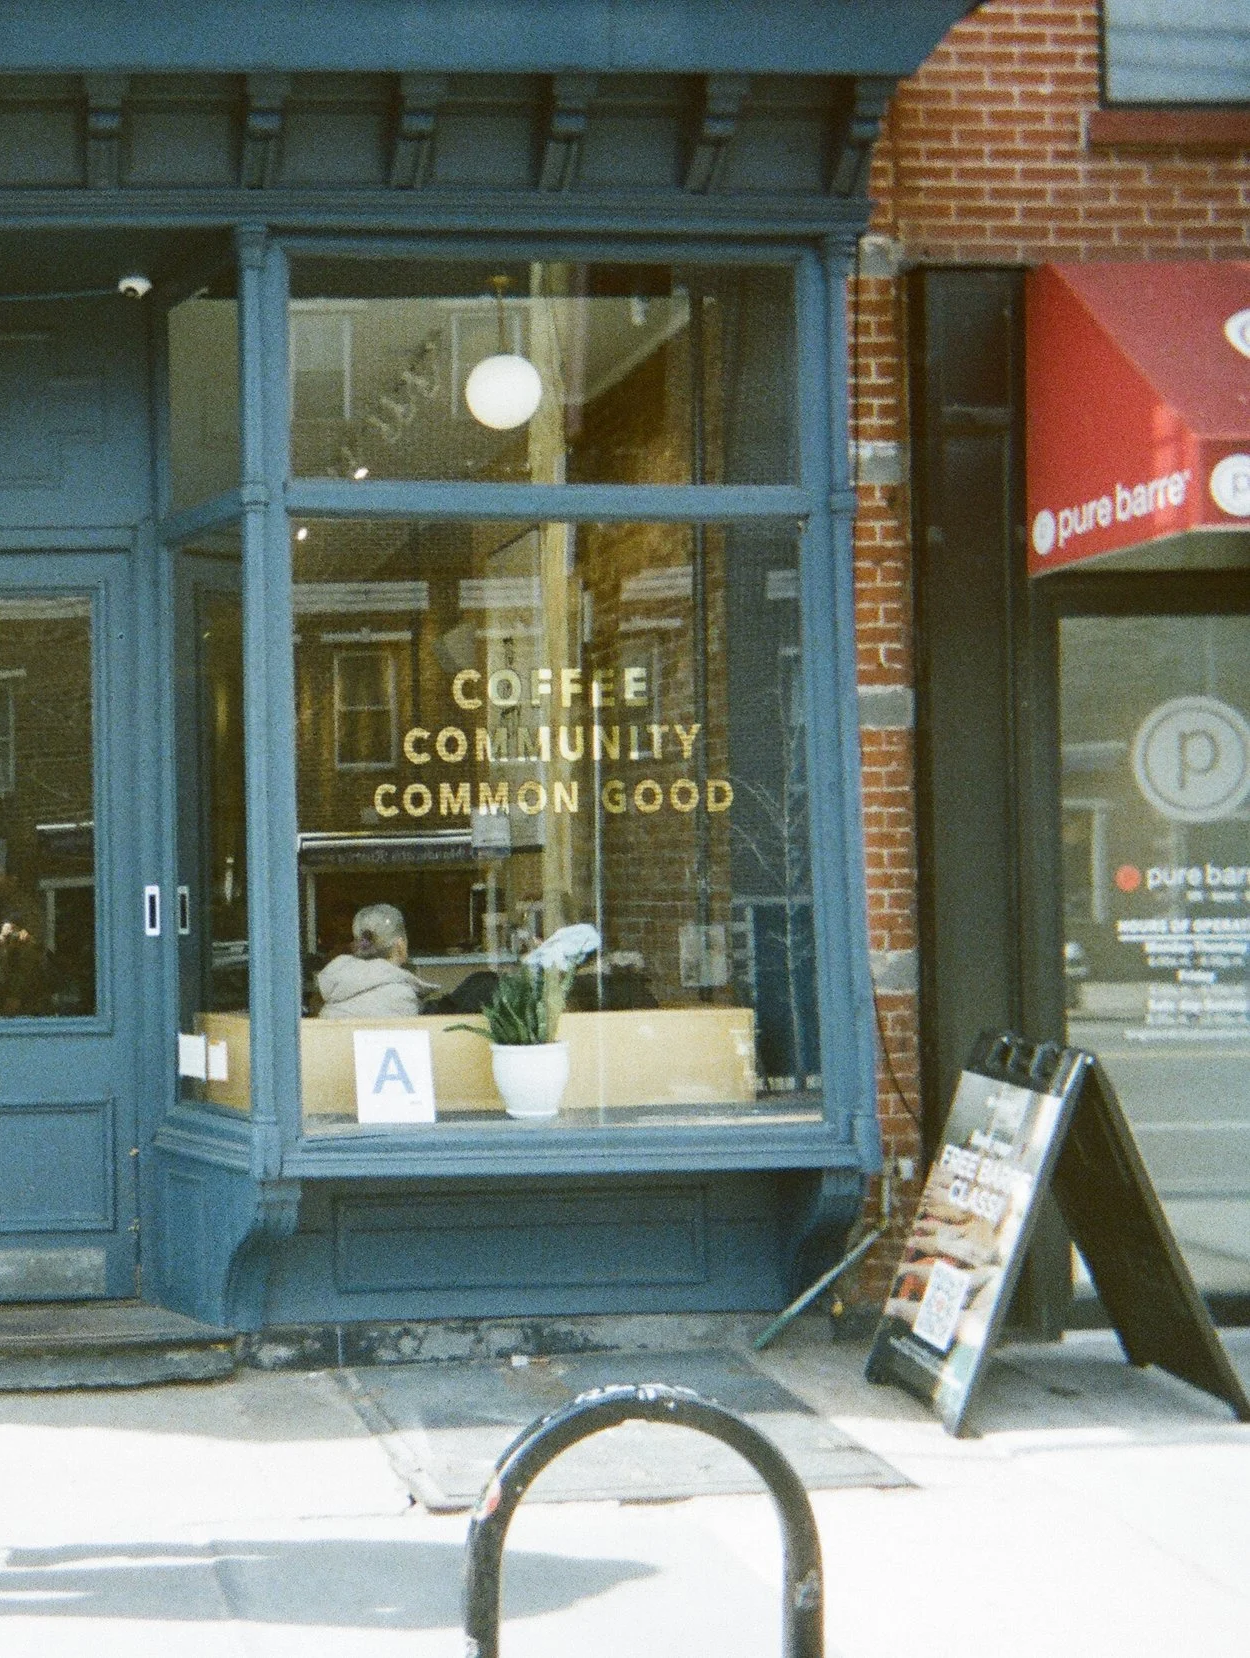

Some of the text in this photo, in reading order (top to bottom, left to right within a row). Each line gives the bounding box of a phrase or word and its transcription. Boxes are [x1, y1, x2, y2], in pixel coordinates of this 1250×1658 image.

[1058, 470, 1187, 548] pure barre
[452, 667, 649, 710] COFFEE
[403, 723, 701, 765] COMMUNITY
[373, 778, 734, 818] COMMON GOOD
[1146, 865, 1202, 890] pure
[372, 1047, 416, 1095] A
[940, 1144, 980, 1182] FREE
